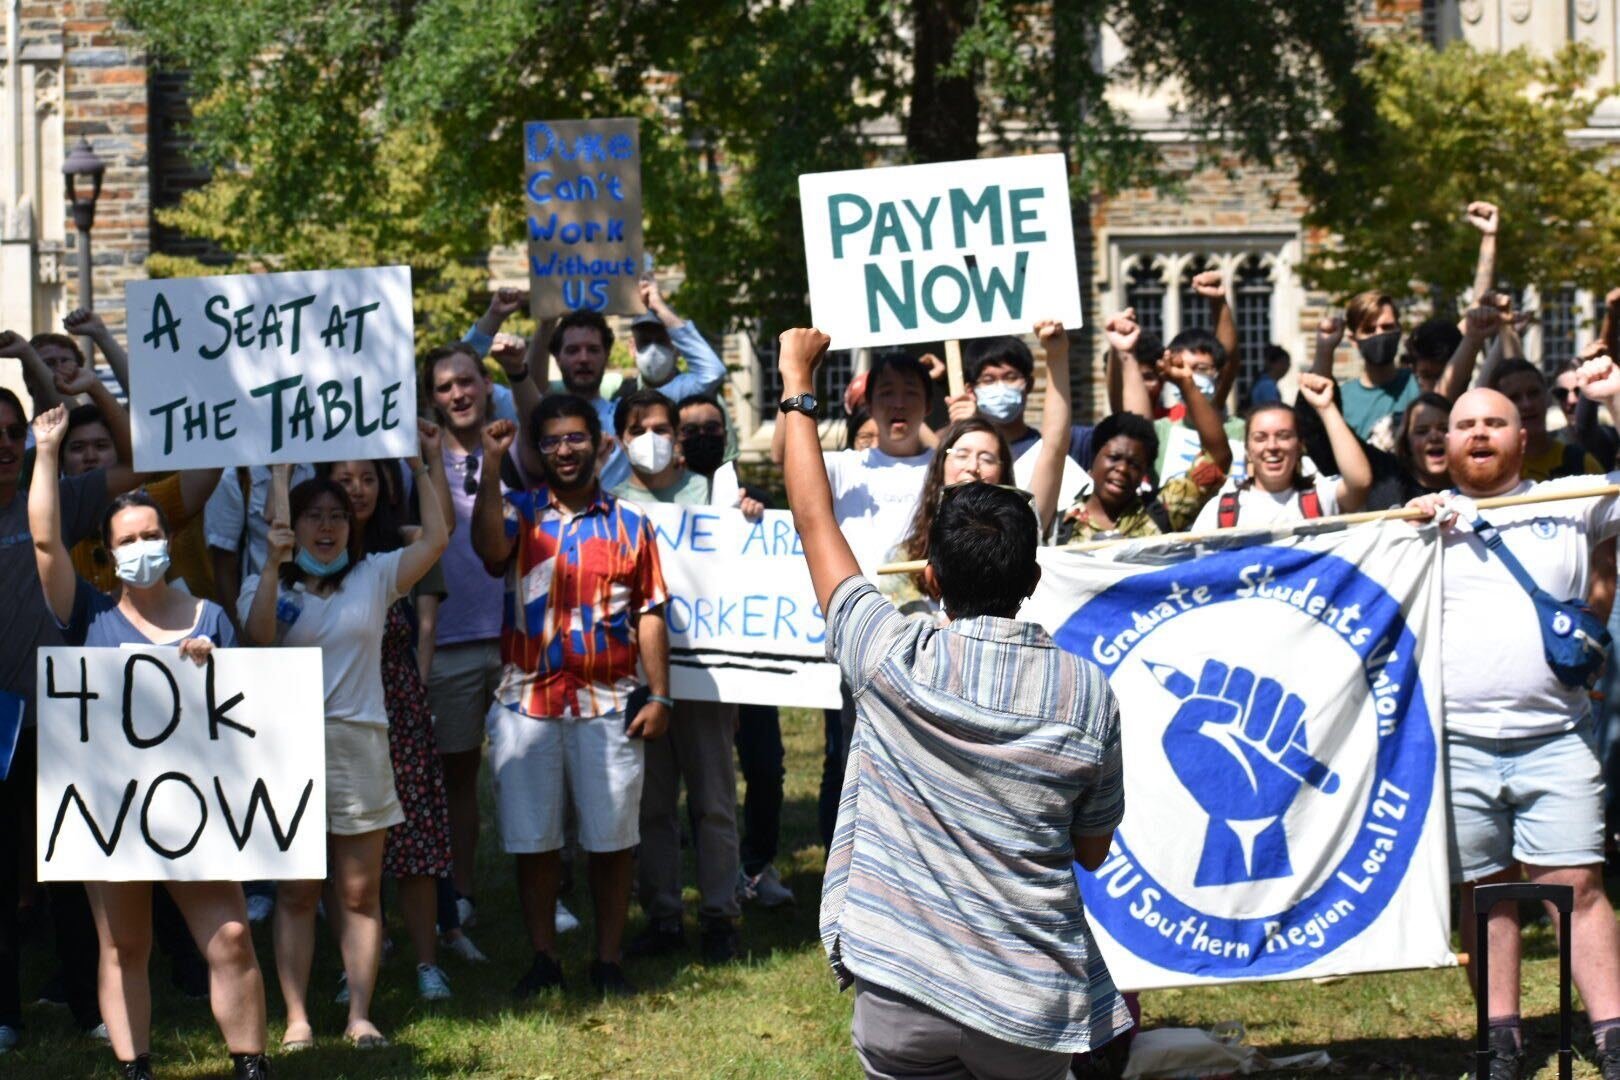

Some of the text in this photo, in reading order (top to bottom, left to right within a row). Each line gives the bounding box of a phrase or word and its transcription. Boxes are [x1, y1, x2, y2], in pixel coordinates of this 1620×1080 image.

[526, 123, 634, 162] Duke
[527, 170, 625, 205] Can't
[528, 212, 625, 245] Work
[827, 184, 1048, 260] PAY ME
[531, 252, 636, 277] Without
[562, 279, 610, 312] US
[864, 251, 1030, 333] NOW
[143, 292, 381, 360] A SEAT AT
[149, 374, 402, 456] THE TABLE
[666, 594, 826, 643] ORKERS
[1092, 581, 1212, 665] Graduate
[1235, 563, 1372, 647] Students
[45, 771, 314, 861] NOW
[1129, 887, 1250, 958] Southern
[1264, 899, 1356, 953] Region
[1336, 822, 1398, 894] Local
[1372, 779, 1410, 820] 27
